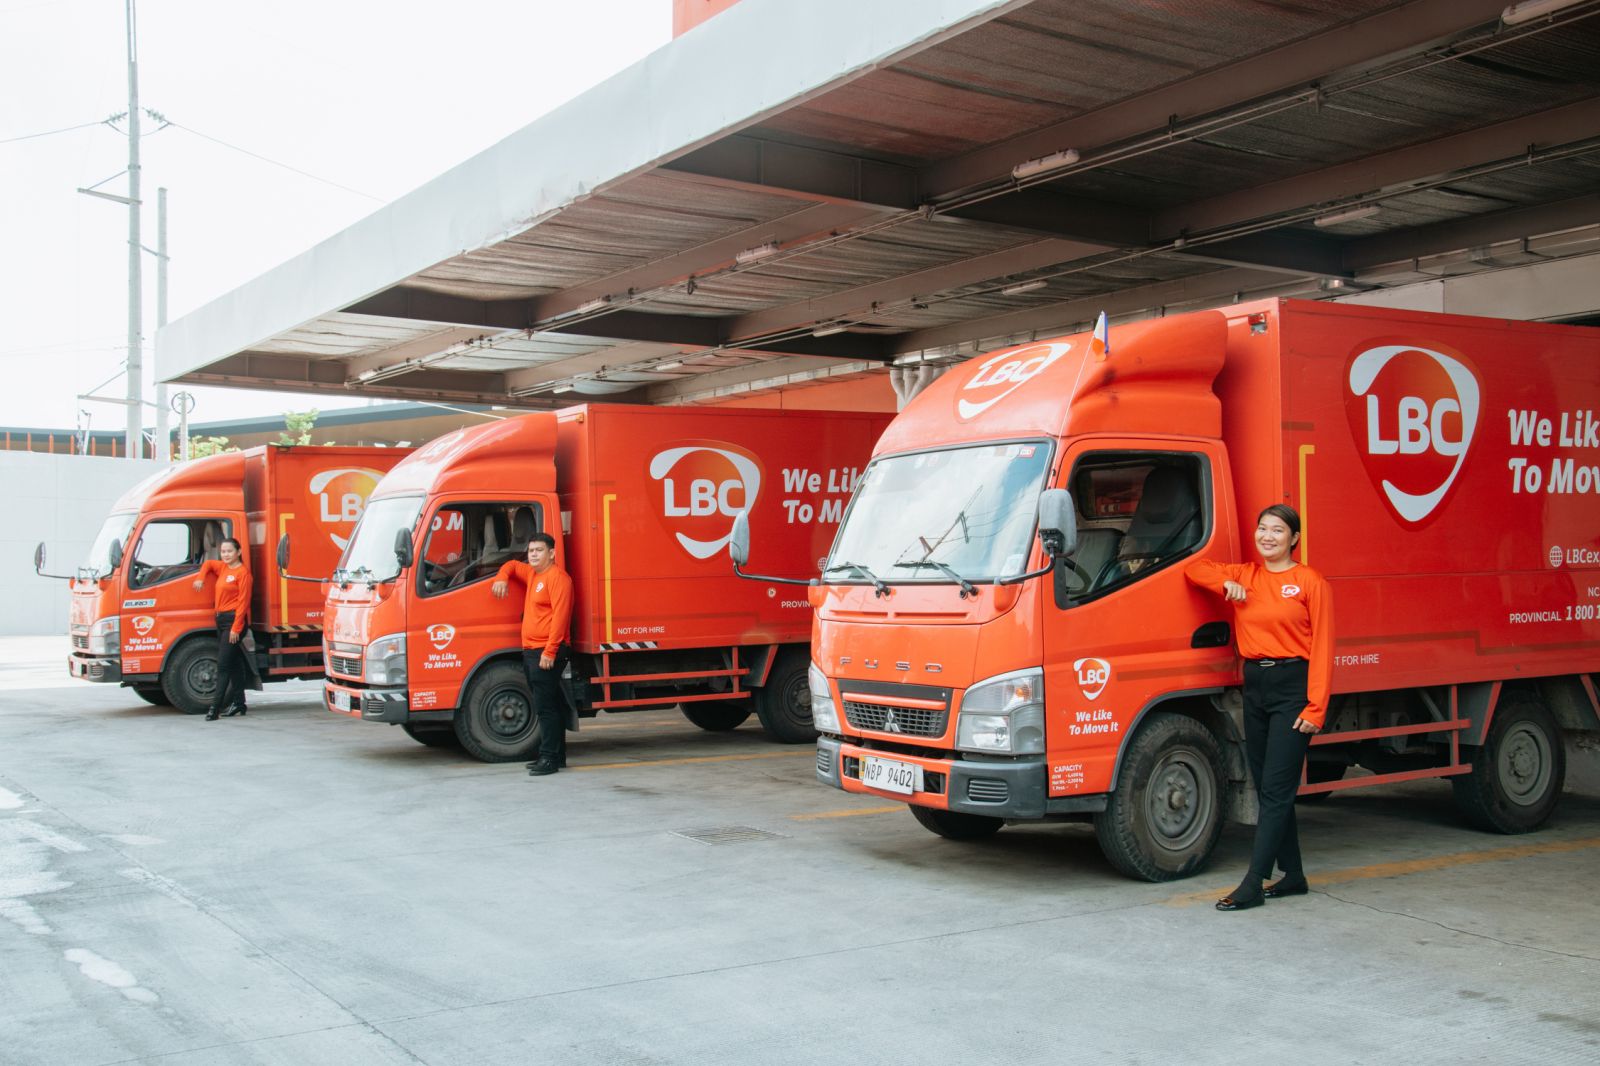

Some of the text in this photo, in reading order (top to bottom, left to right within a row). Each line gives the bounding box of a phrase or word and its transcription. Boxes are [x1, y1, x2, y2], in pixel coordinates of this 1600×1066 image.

[963, 356, 1046, 390] LBC
[1367, 394, 1465, 456] LBC
[1508, 408, 1600, 448] We Lik
[782, 467, 863, 493] We Lik
[1508, 457, 1600, 494] To Mov
[320, 492, 368, 522] LB
[663, 478, 746, 517] LBC
[782, 499, 813, 524] To
[1566, 548, 1600, 564] LBCex
[1587, 586, 1600, 597] NC
[1509, 611, 1561, 624] PROVINCIAL
[1566, 605, 1572, 620] 1
[1575, 605, 1594, 620] 800
[617, 625, 665, 635] NOT FOR HIRE
[840, 656, 943, 673] FUSO
[1341, 655, 1359, 666] FOR
[1360, 653, 1380, 665] HIRE
[1078, 669, 1107, 685] LBC
[1075, 709, 1113, 722] We Like
[1069, 721, 1119, 736] To Move It
[864, 762, 913, 788] NBP 9402
[1054, 764, 1083, 773] CAPACITY
